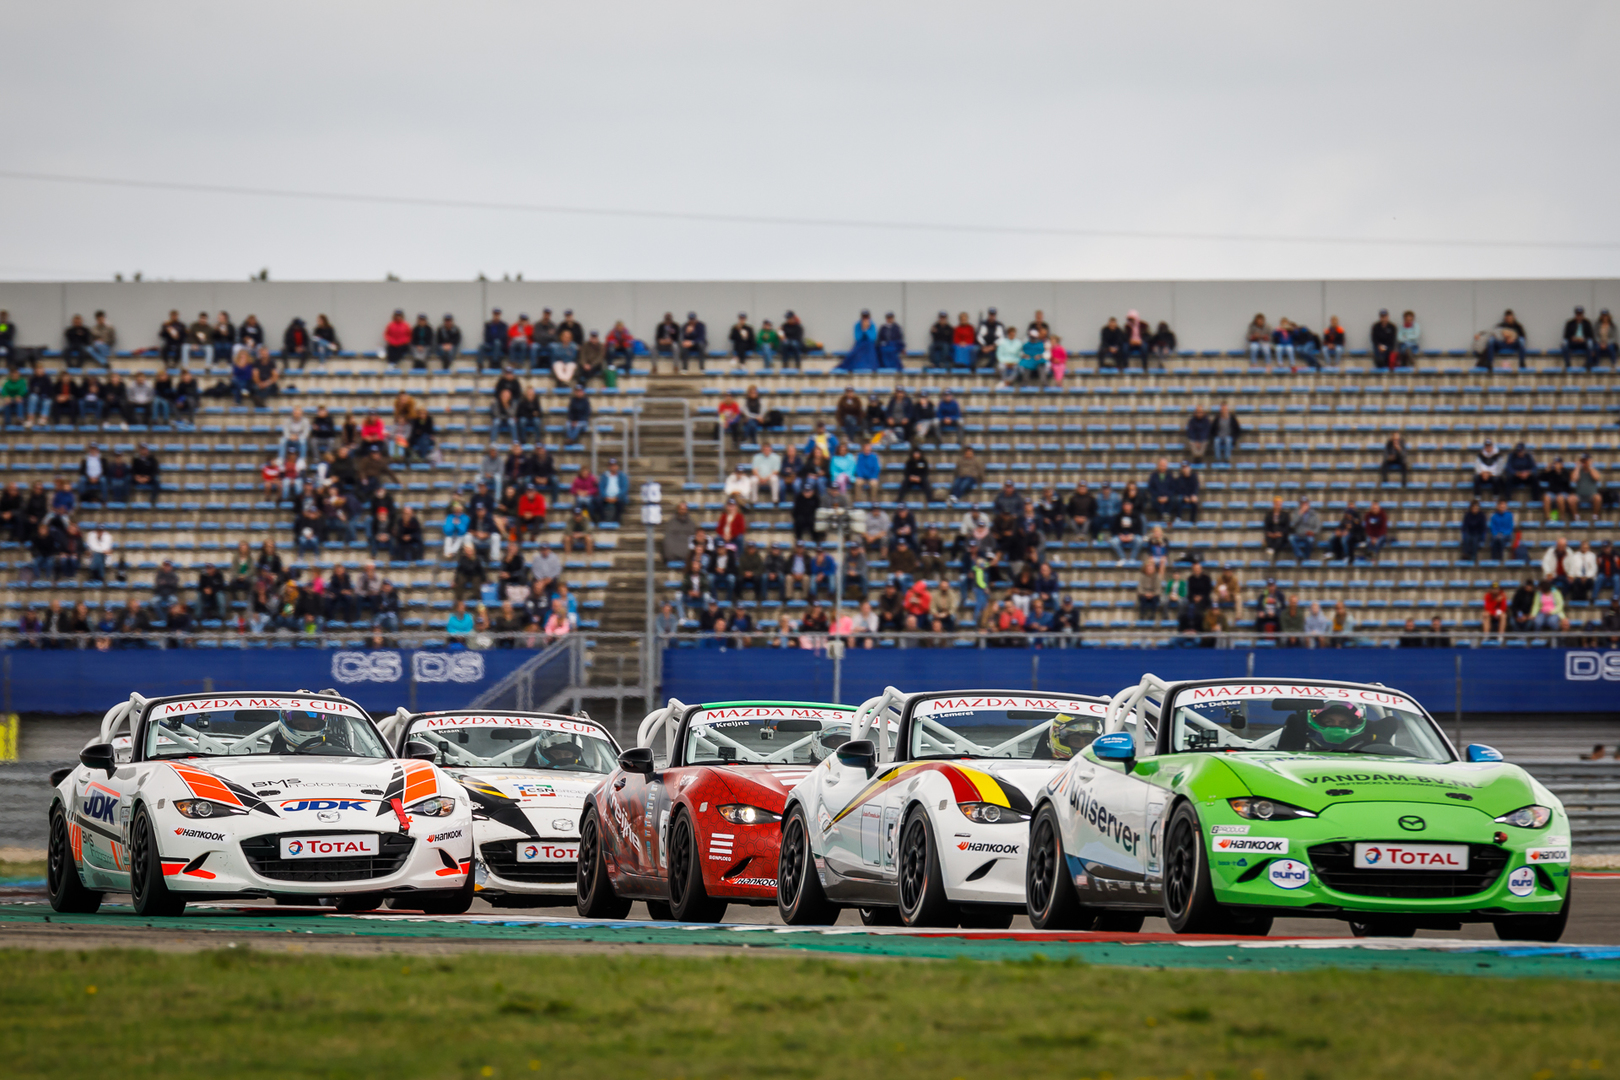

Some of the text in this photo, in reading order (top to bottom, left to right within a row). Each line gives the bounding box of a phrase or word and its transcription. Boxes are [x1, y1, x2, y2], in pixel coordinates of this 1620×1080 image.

[1193, 686, 1404, 705] MAZDA MX-5 CUP
[165, 699, 349, 714] MAZDA MX-5 CUP
[933, 698, 1018, 710] MAZDA
[1024, 699, 1080, 710] MX-5
[1208, 700, 1242, 708] Dekker
[706, 708, 785, 720] MAZDA
[791, 709, 843, 720] MX-5
[426, 717, 499, 728] MAZDA
[504, 717, 552, 727] MX-5
[560, 721, 596, 734] CUP
[716, 719, 750, 728] Kreijne
[692, 726, 706, 738] 3
[1303, 774, 1483, 789] VANDAM-BV.NL
[83, 789, 120, 825] JDK
[282, 801, 368, 812] JDK
[1069, 780, 1140, 856] uniserver
[306, 840, 371, 853] TOTAL
[541, 846, 580, 858] TOT
[1386, 848, 1460, 865] TOTAL
[1272, 870, 1306, 880] eurol
